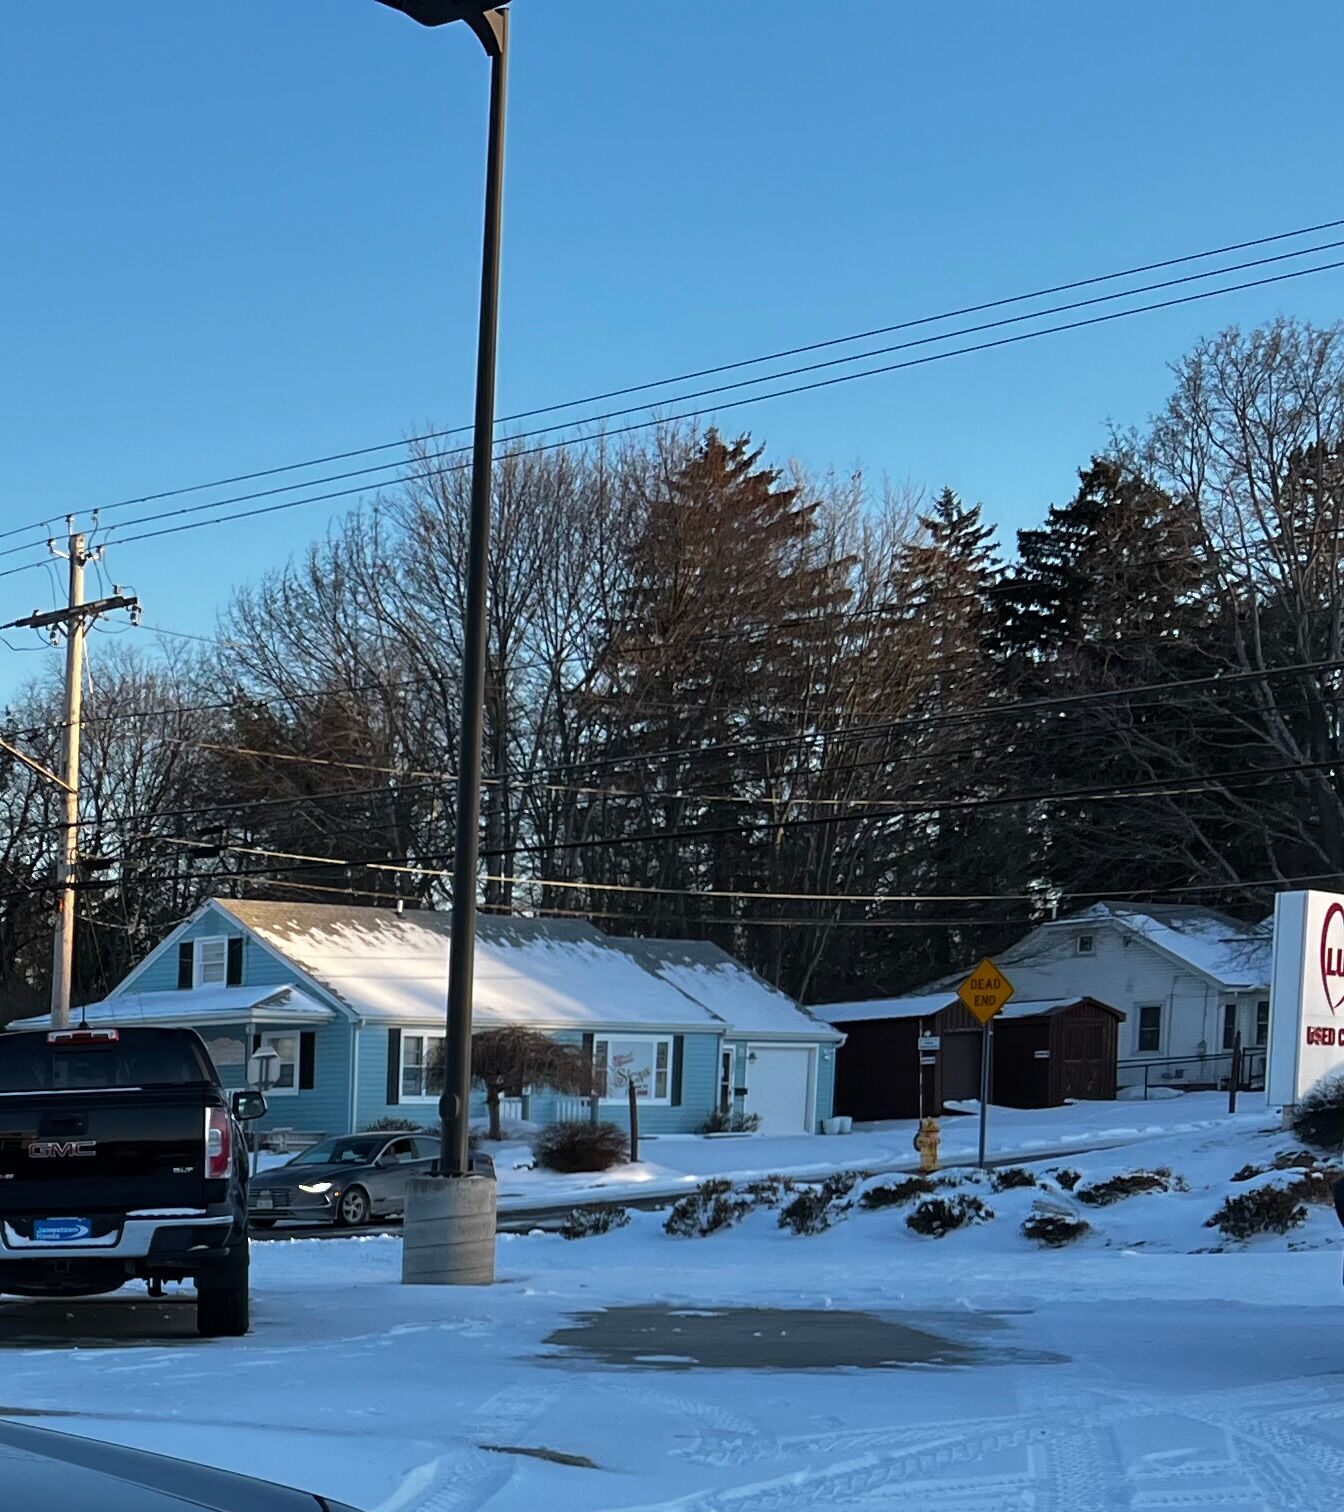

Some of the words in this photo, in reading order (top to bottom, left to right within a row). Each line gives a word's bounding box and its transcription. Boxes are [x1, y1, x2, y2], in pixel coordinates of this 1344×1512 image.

[970, 978, 1001, 990] DEAD
[974, 995, 997, 1006] END
[1306, 1026, 1335, 1046] USED
[28, 1140, 97, 1158] GMC
